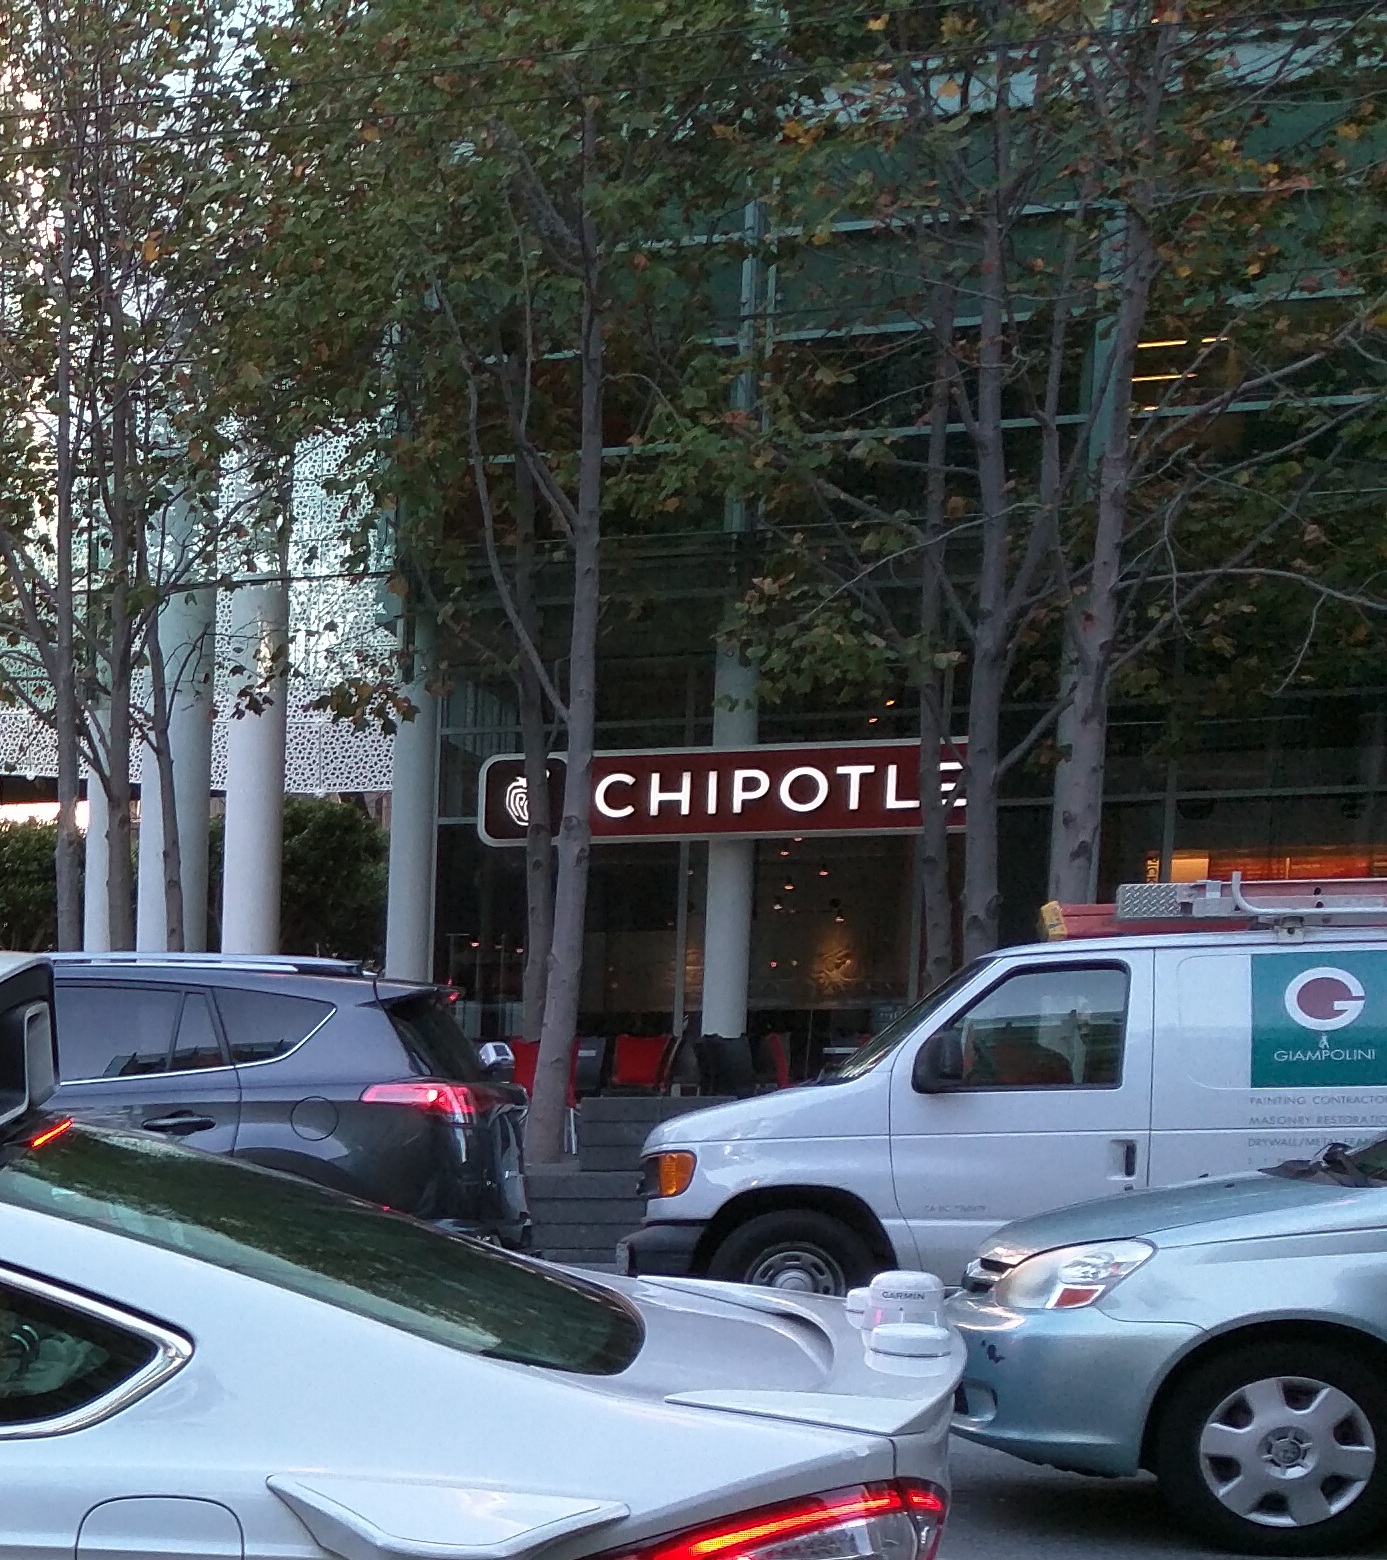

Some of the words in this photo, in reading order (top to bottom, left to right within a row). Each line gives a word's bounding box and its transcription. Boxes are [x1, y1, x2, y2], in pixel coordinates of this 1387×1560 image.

[1273, 1048, 1376, 1062] GIAMPOLINI
[1249, 1096, 1307, 1105] PAINTING
[1249, 1115, 1312, 1126] MASONRY
